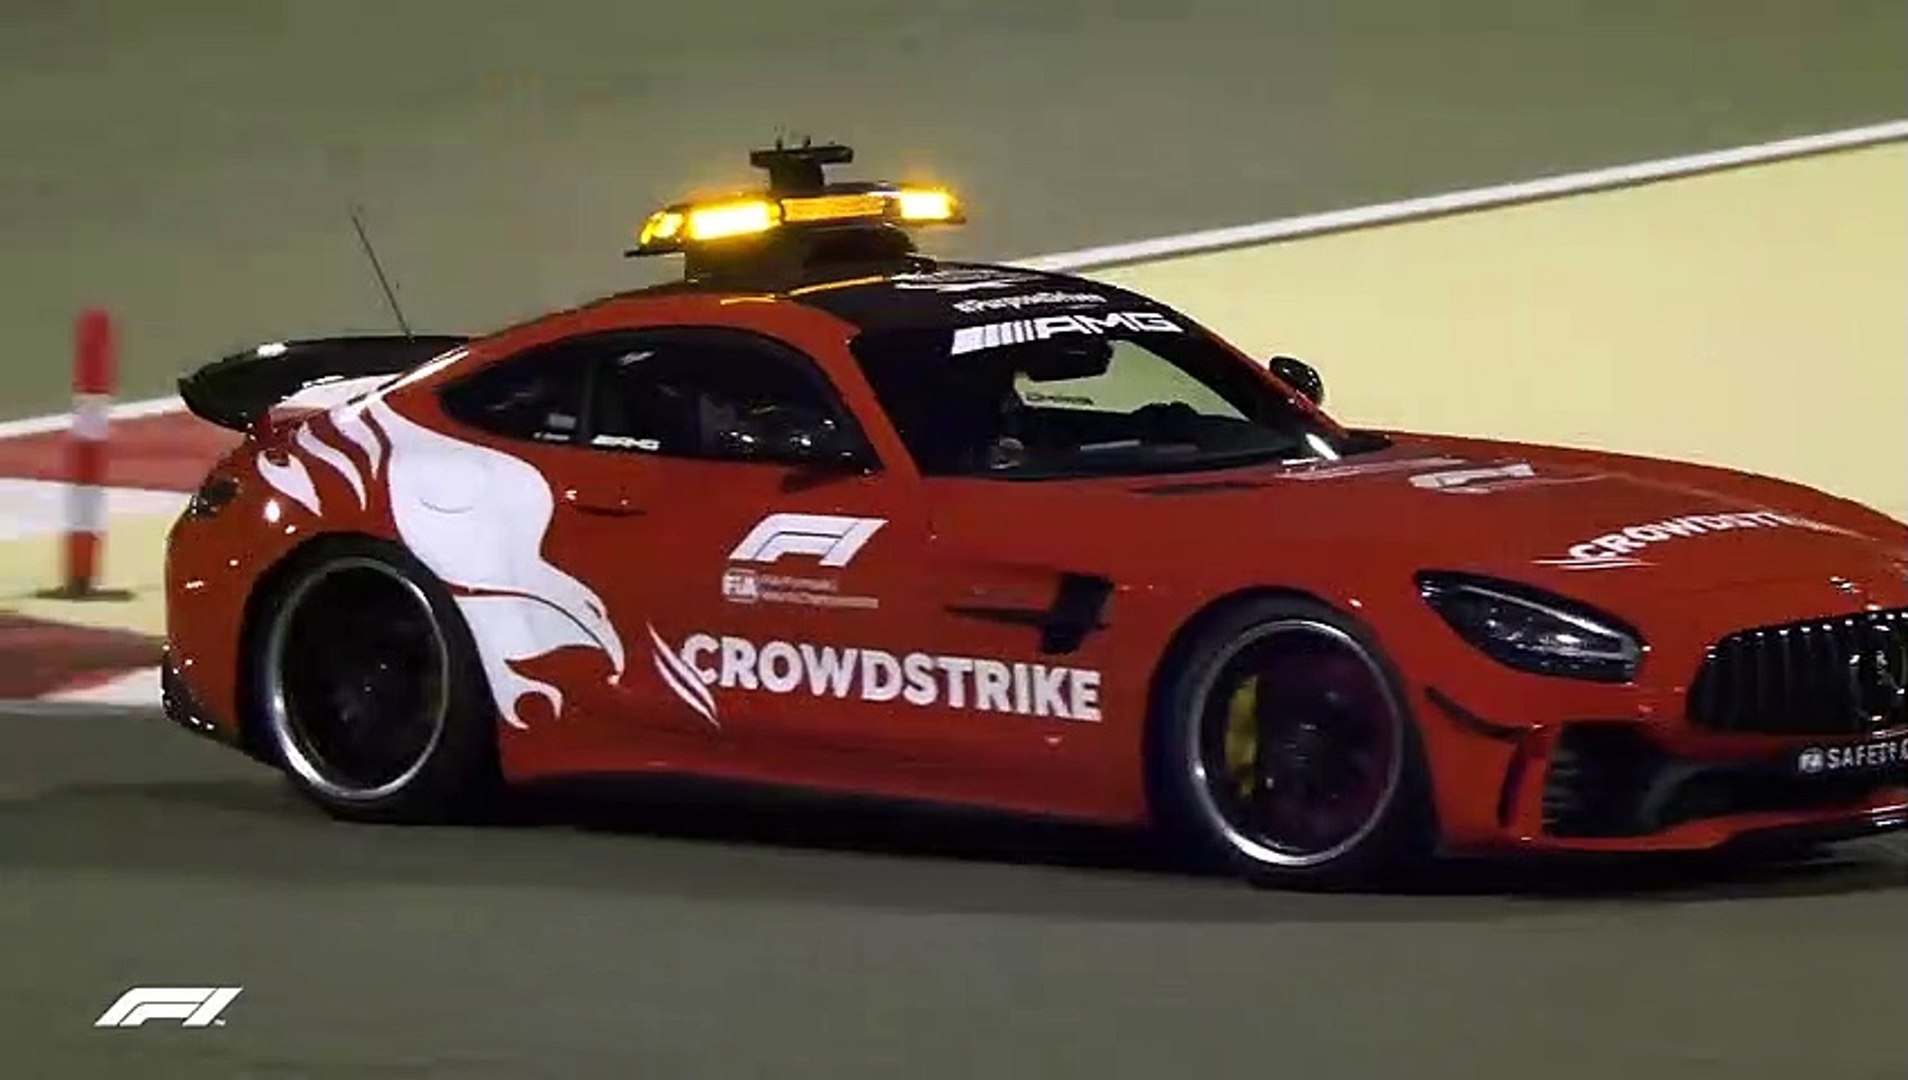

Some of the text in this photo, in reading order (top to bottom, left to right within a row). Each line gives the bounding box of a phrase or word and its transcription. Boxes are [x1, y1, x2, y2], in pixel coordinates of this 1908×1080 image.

[1036, 311, 1183, 340] AMG
[728, 512, 889, 567] F1
[680, 632, 1103, 723] CROWDSTRIKE
